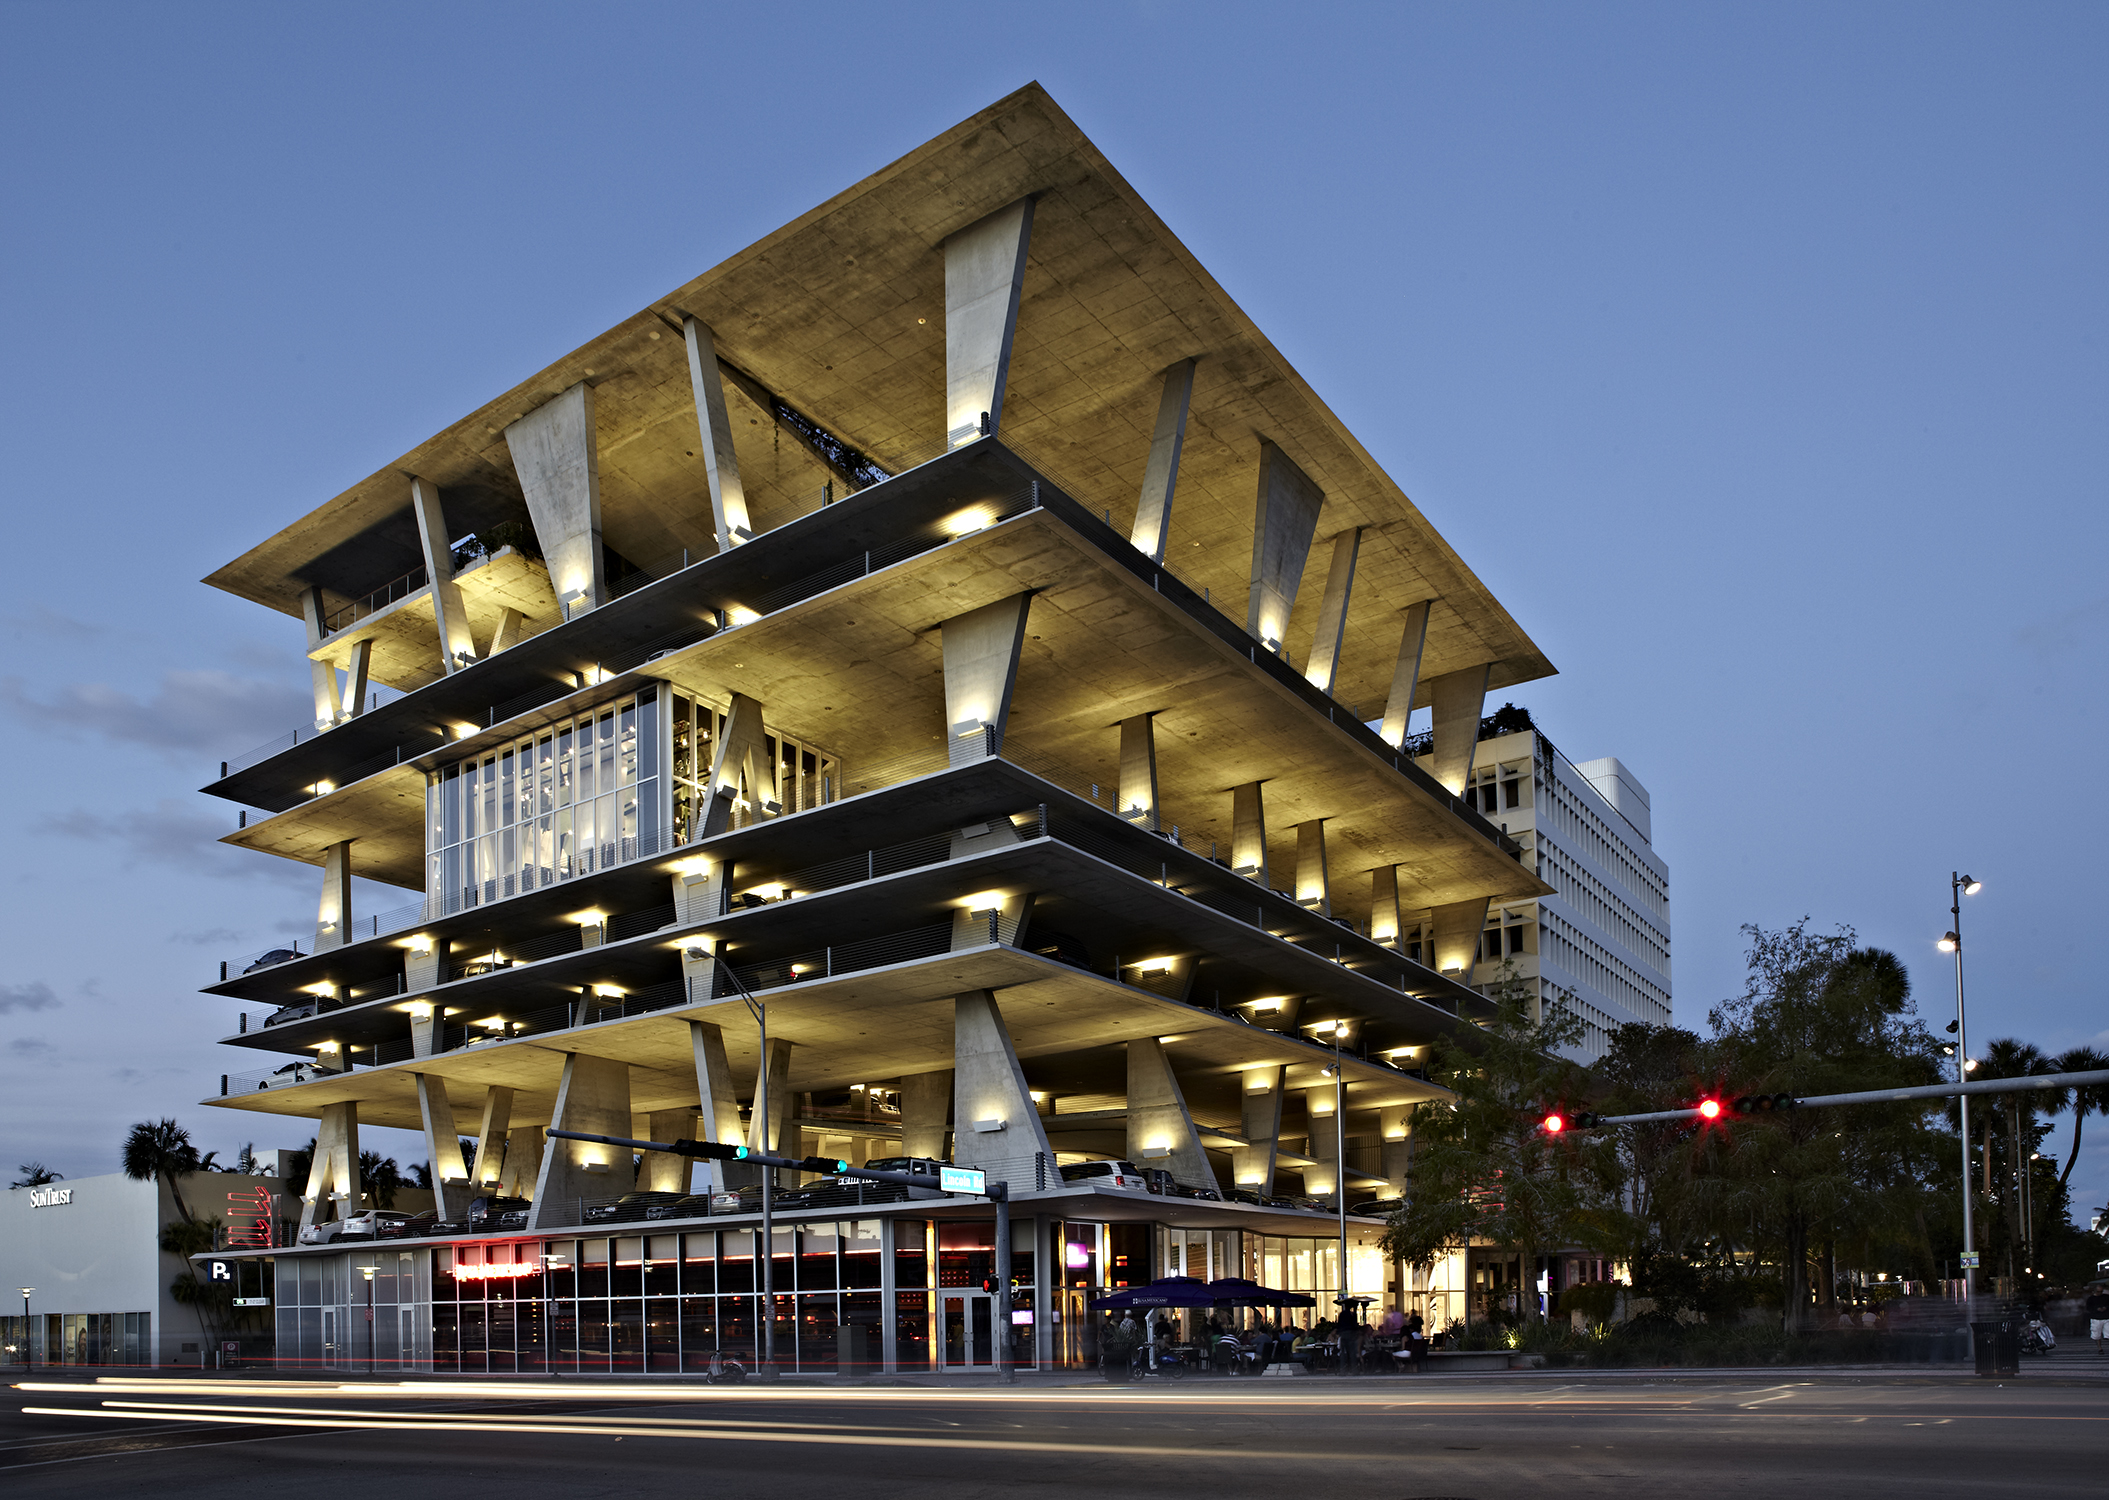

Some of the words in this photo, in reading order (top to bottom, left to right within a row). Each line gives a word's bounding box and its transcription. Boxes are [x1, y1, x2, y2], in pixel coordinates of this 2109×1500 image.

[942, 1172, 970, 1187] Lincoln
[973, 1175, 983, 1189] Rd
[212, 1262, 226, 1279] P
